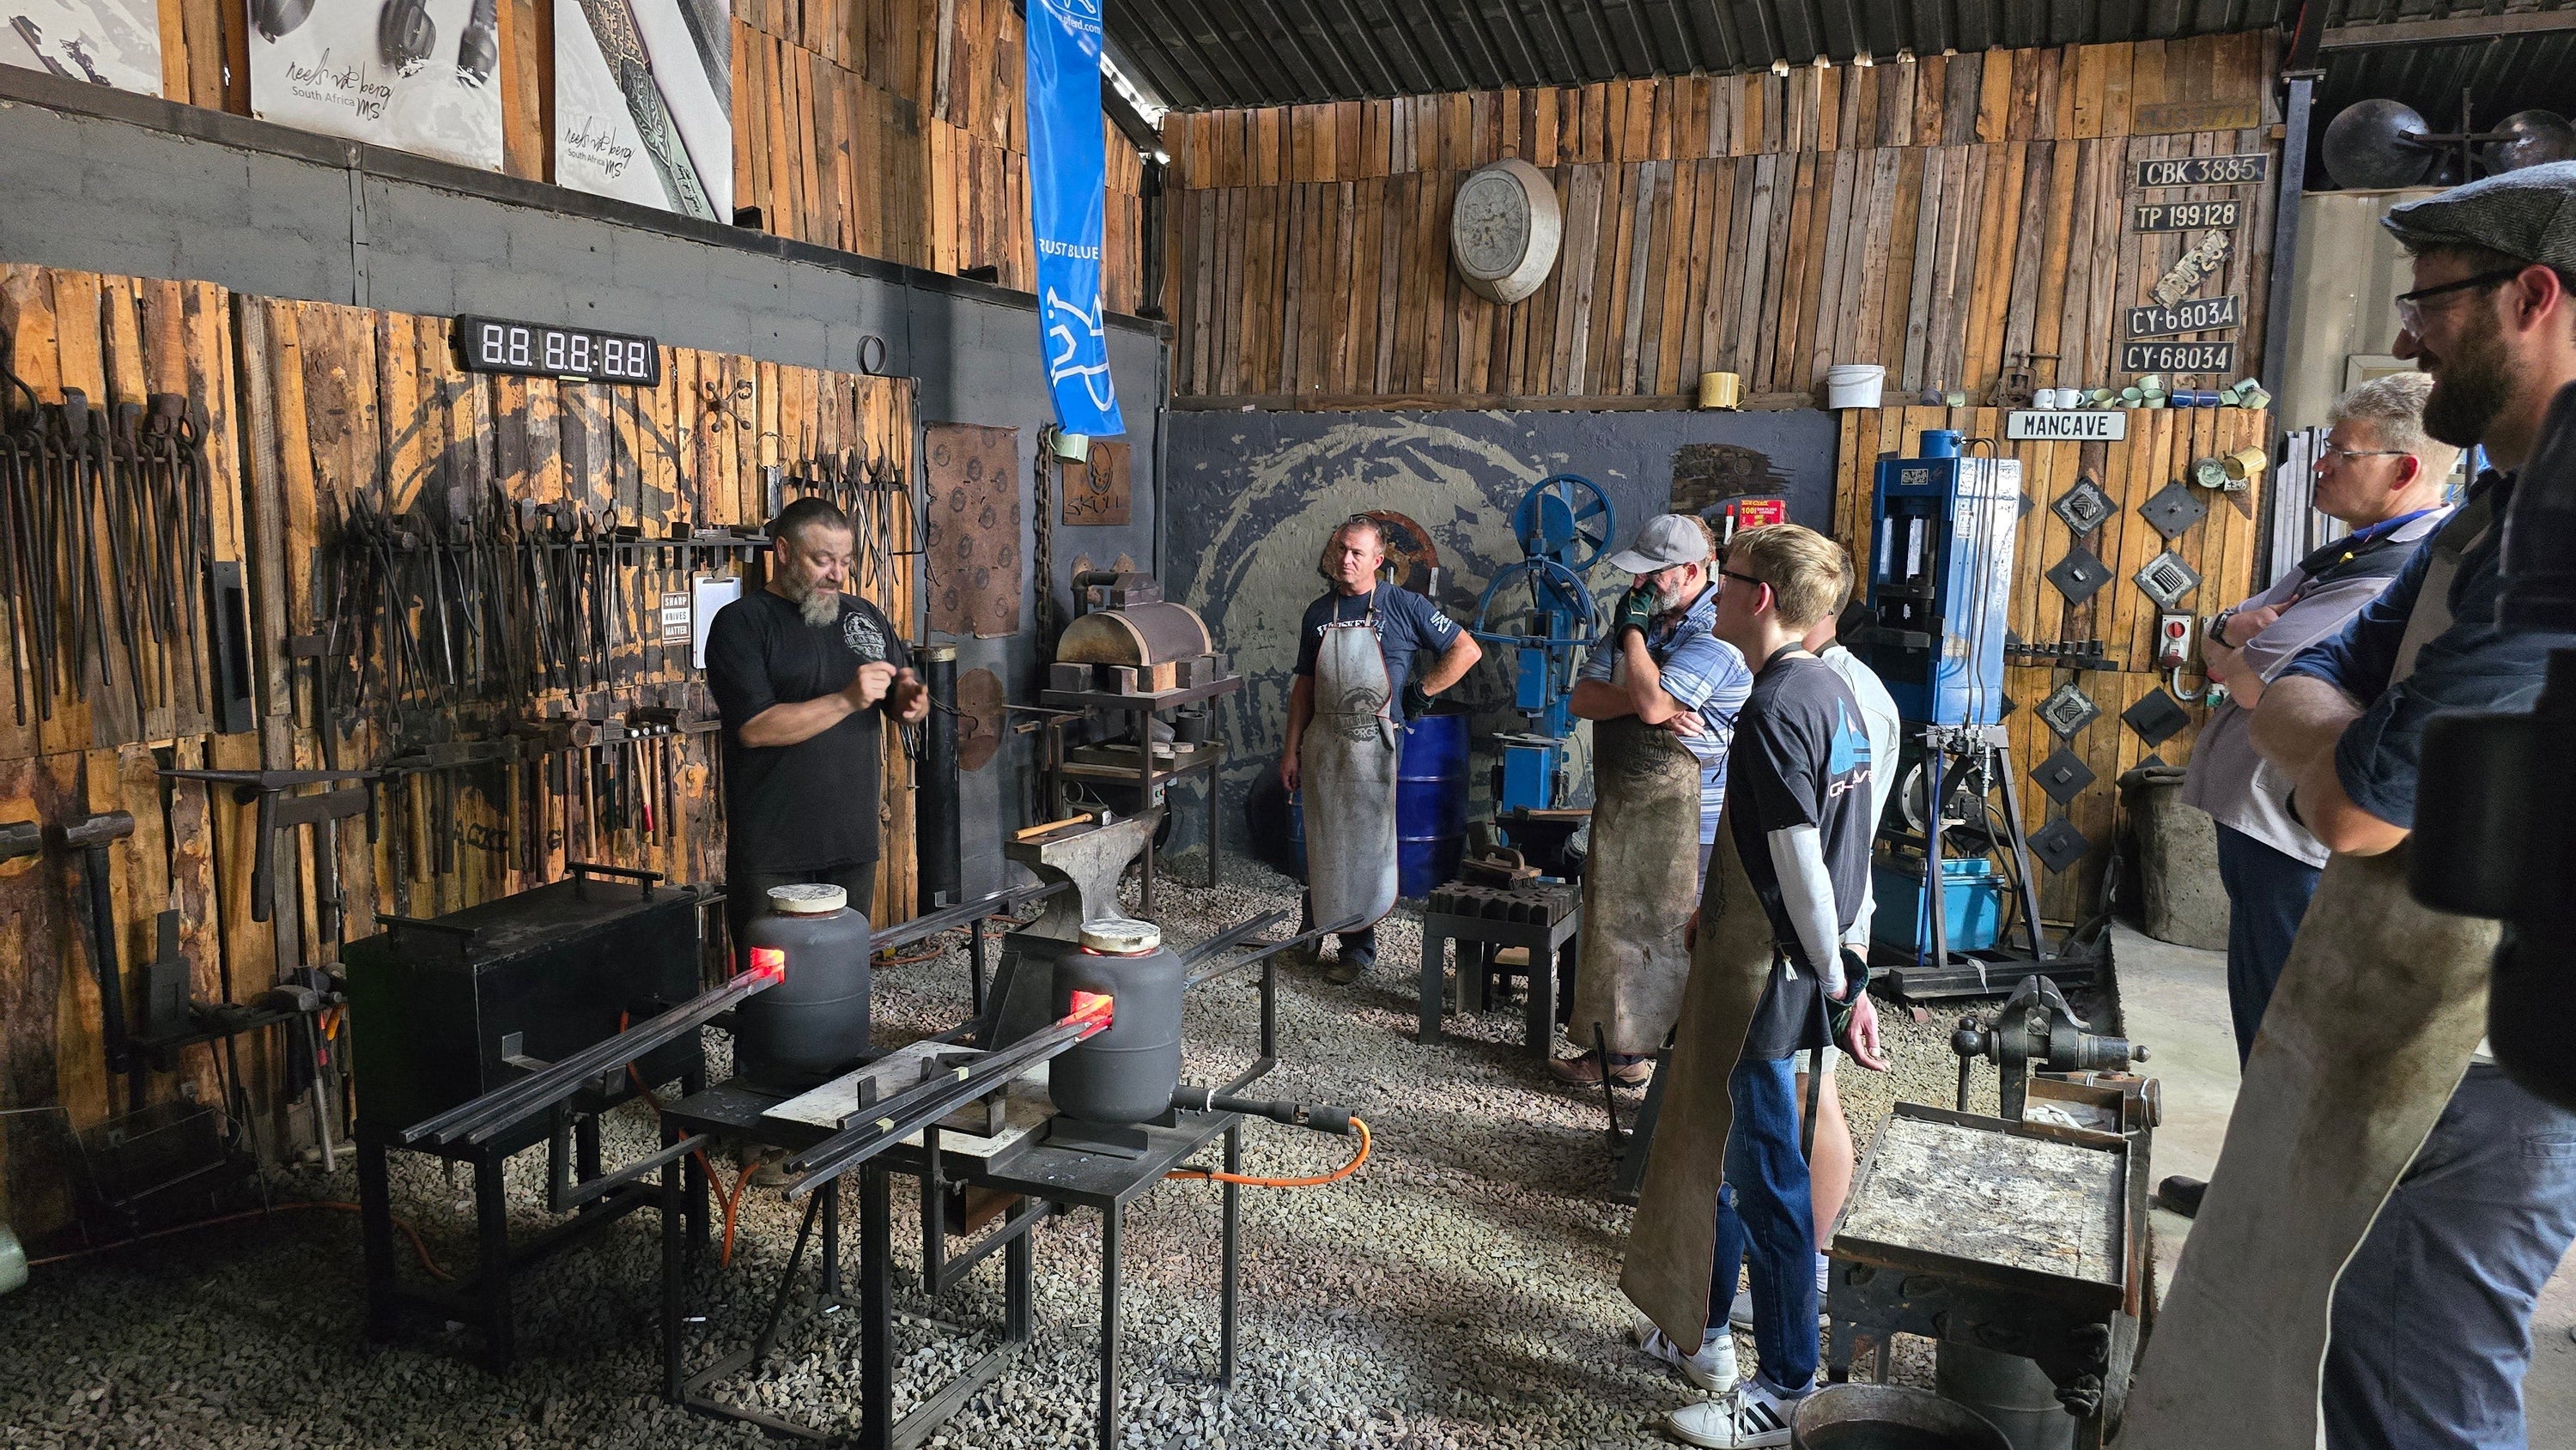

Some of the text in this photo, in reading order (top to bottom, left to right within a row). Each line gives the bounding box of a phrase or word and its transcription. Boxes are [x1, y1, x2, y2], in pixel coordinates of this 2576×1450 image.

[292, 86, 355, 106] South Africa
[568, 148, 605, 167] South Africa
[2147, 158, 2257, 185] CBK 3885
[2138, 207, 2162, 228] TP
[1067, 244, 1099, 260] BLUE
[2024, 416, 2109, 436] MANCAVE
[1065, 494, 1128, 516] SKULL
[665, 596, 688, 607] SHARP
[665, 611, 687, 622] KNIVES
[665, 625, 688, 636] MATTER
